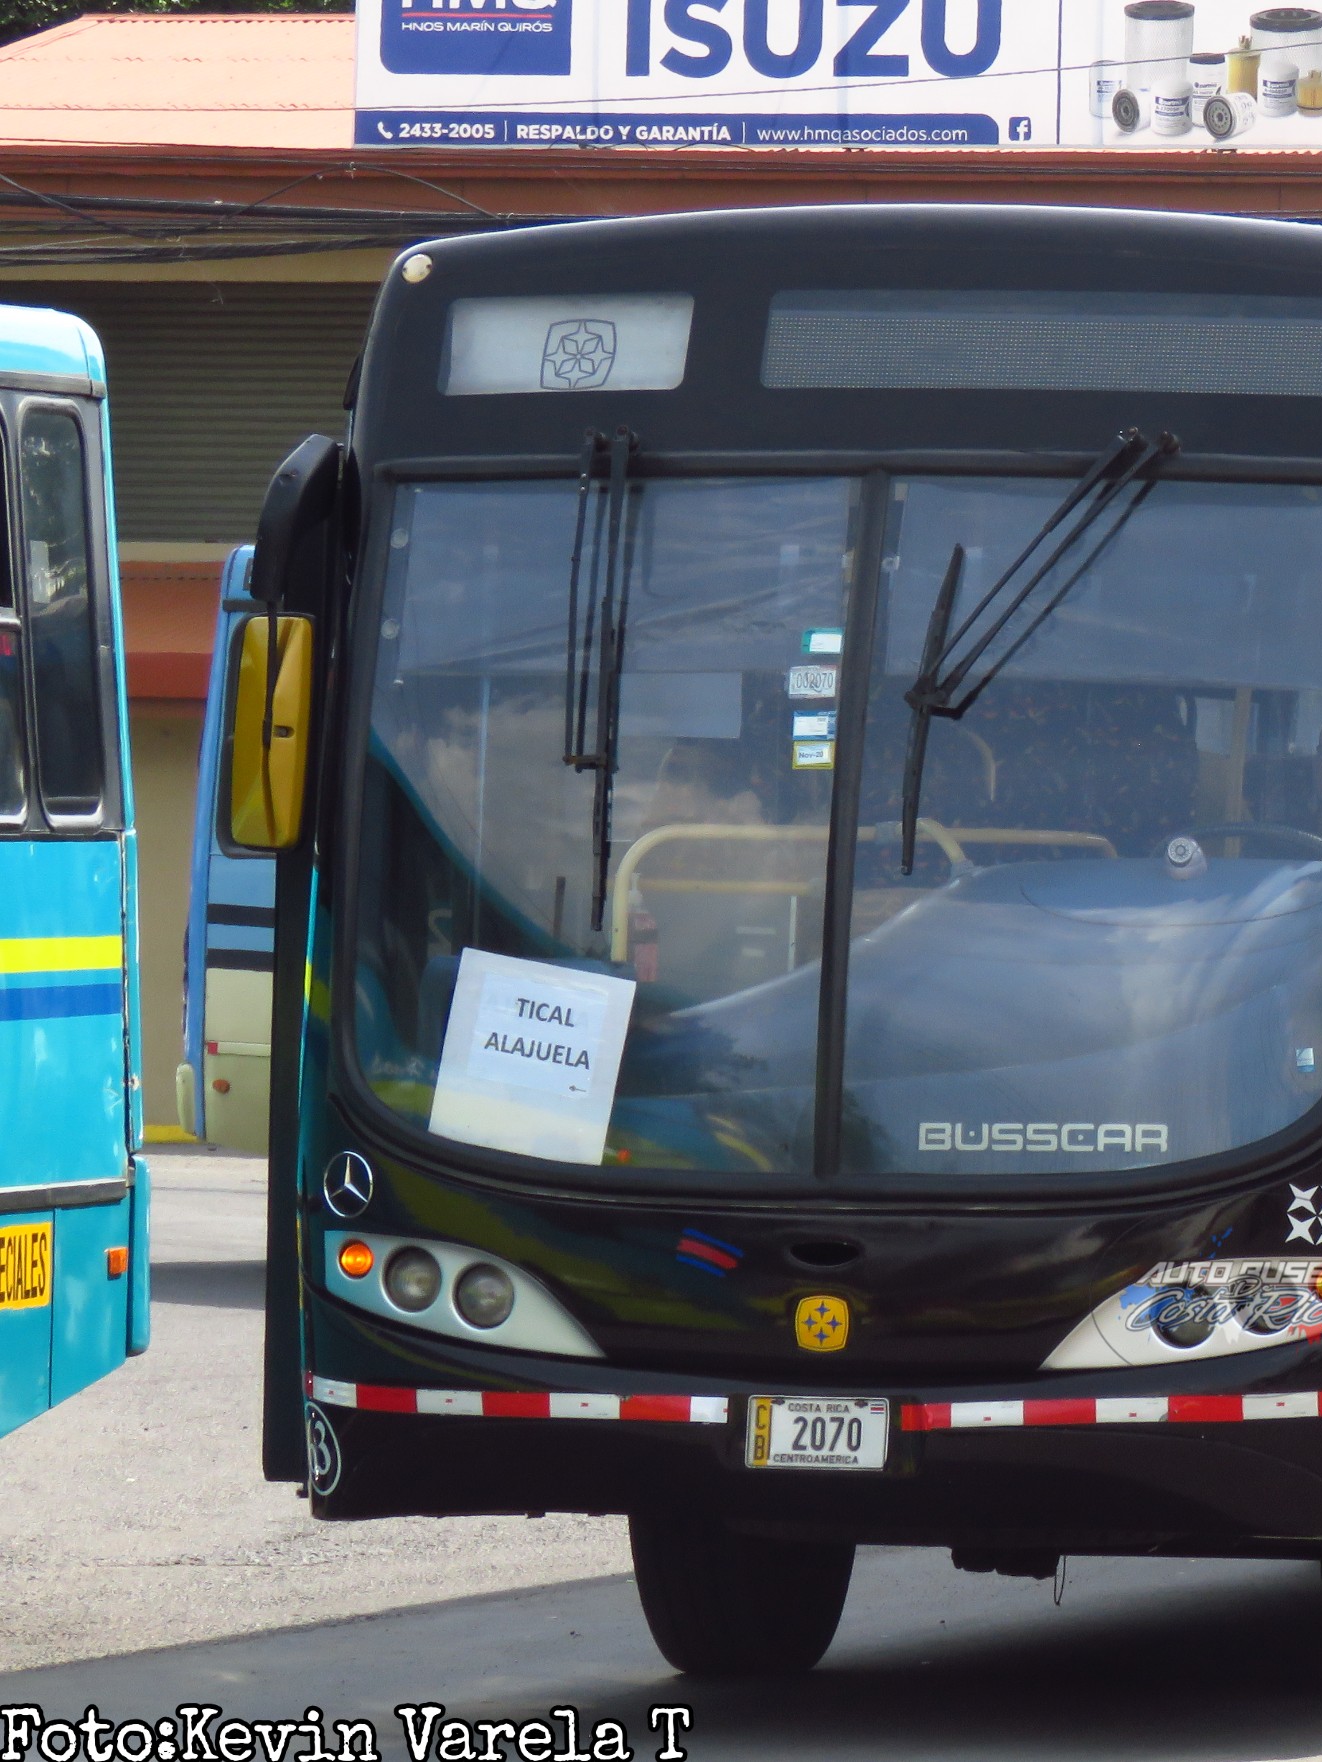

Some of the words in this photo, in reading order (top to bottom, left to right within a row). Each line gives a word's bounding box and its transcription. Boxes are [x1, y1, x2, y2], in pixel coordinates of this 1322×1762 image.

[401, 22, 443, 32] HNOS
[446, 20, 495, 32] MARÍN
[497, 20, 553, 33] QUIRÓS
[625, 0, 1001, 79] ISUZU
[398, 122, 495, 139] 2433-2005
[516, 124, 614, 141] RESPALDO
[618, 125, 631, 140] Y
[635, 122, 732, 142] GARANTÍA
[756, 126, 969, 144] www.hmqasociados.com
[517, 997, 575, 1028] TICAL
[483, 1031, 591, 1071] ALAJUELA
[918, 1122, 1169, 1153] BUSSCAR
[788, 1403, 822, 1413] COSTA
[826, 1403, 850, 1414] RICA
[791, 1415, 863, 1452] 2070
[773, 1453, 859, 1465] CENTROAMERICA
